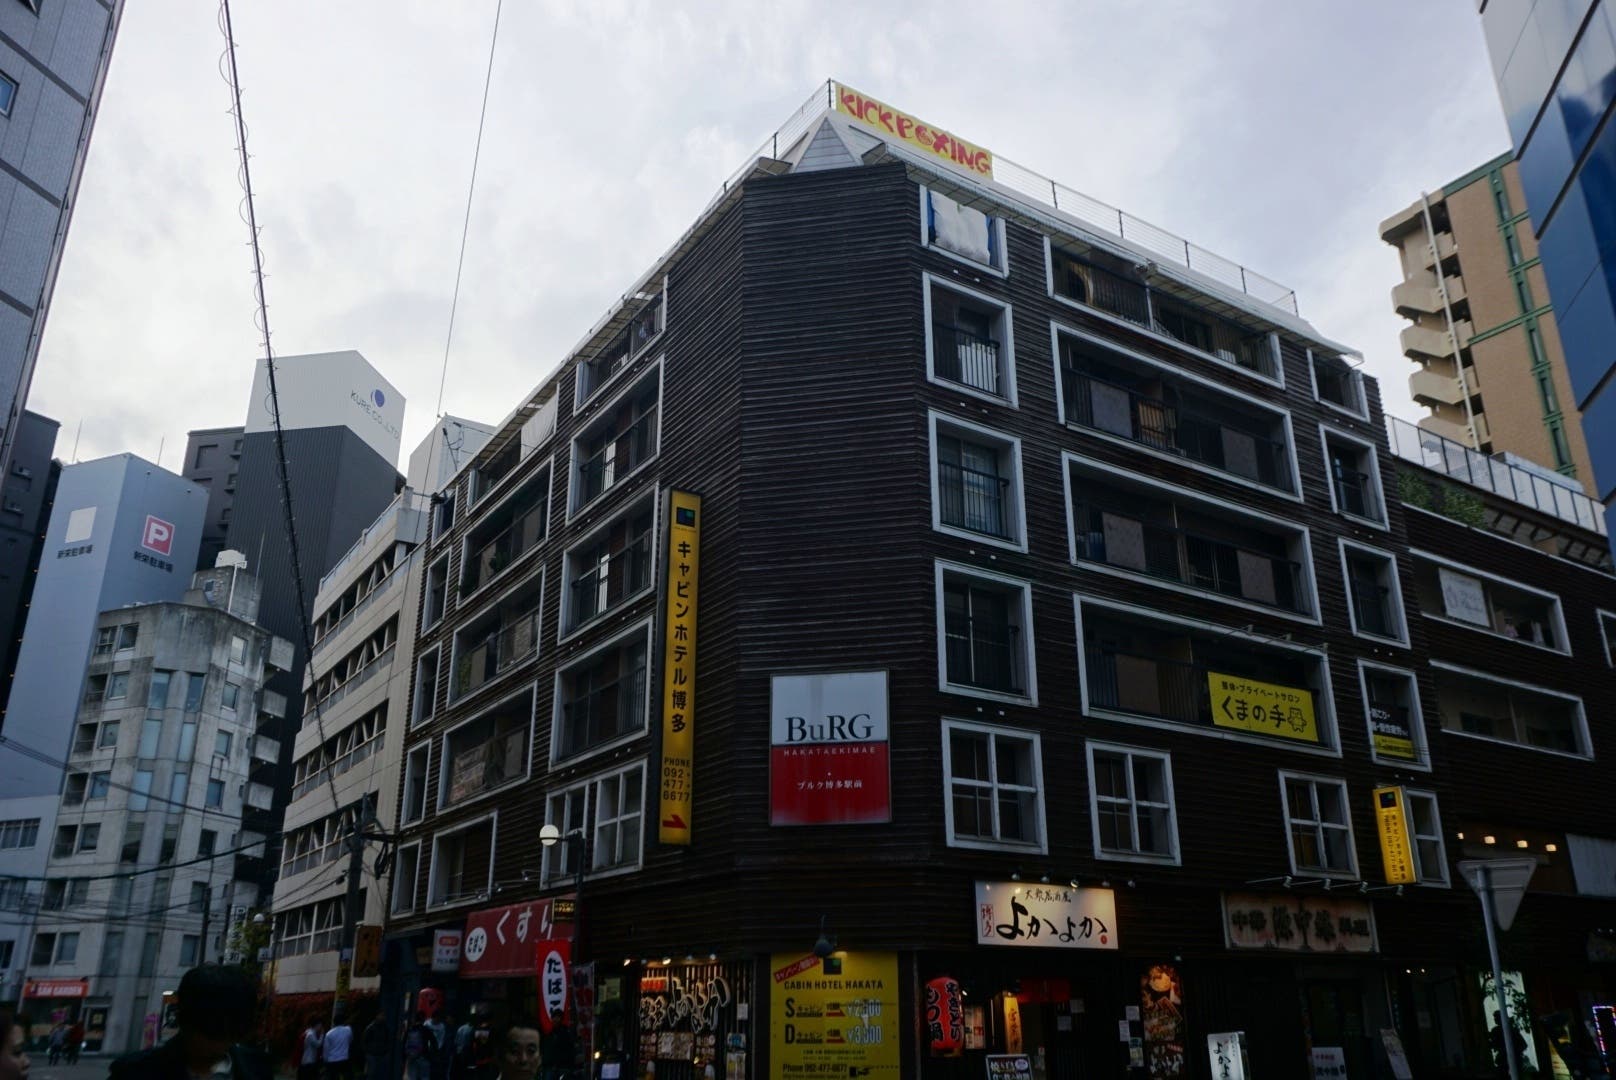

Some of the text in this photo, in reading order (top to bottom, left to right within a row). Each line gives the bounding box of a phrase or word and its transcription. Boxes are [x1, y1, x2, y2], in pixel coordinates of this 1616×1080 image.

[671, 540, 692, 734] キャビンホテル博多
[1221, 695, 1287, 730] くまの手
[784, 713, 875, 742] BuRG
[664, 756, 690, 768] PHONE
[784, 746, 877, 757] HAKATAEKIMAE
[663, 790, 690, 802] 6677
[496, 903, 553, 945] くすり
[996, 895, 1108, 943] よかよか
[547, 957, 562, 1017] たばこ
[784, 979, 884, 990] CABIN HOTEL HAKATA
[785, 997, 795, 1018] S
[785, 1023, 795, 1045] D
